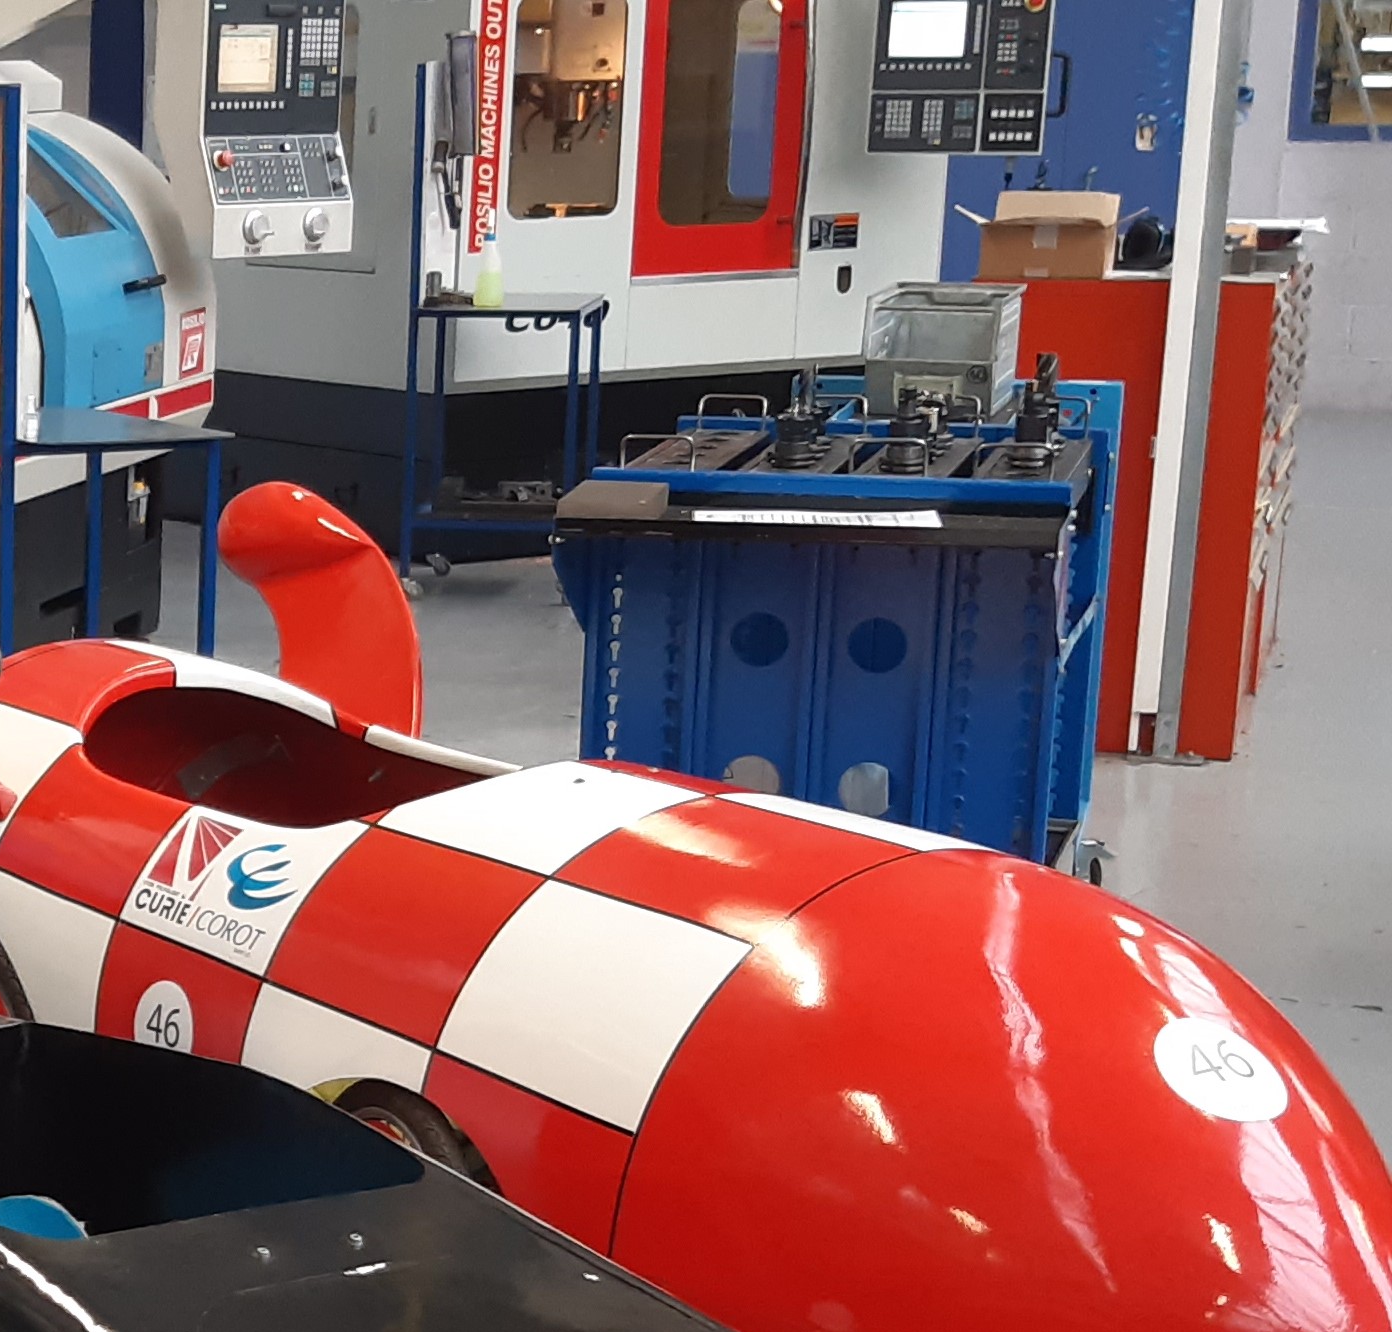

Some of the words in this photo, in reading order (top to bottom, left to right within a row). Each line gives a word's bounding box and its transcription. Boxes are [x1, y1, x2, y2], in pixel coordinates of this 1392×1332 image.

[481, 44, 500, 158] MACHINES
[146, 1003, 180, 1048] 46
[1191, 1040, 1254, 1082] 46
